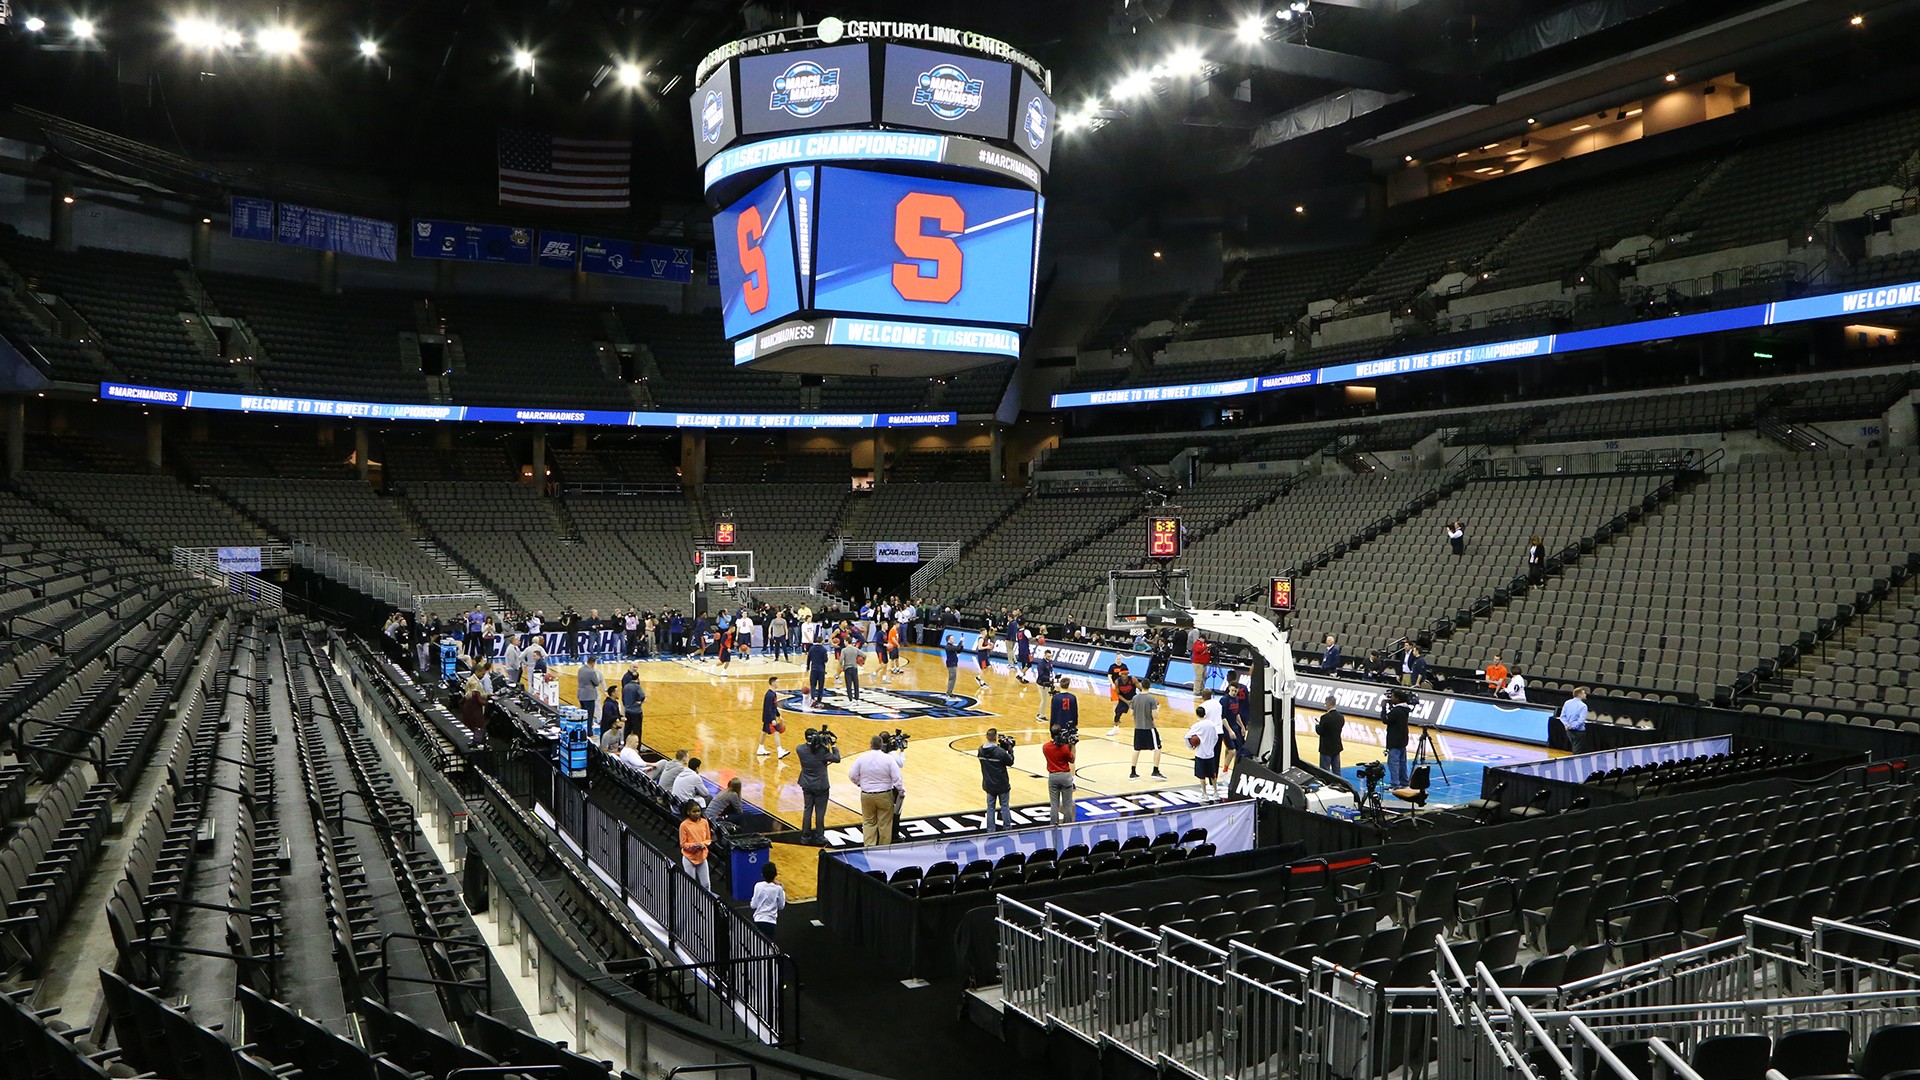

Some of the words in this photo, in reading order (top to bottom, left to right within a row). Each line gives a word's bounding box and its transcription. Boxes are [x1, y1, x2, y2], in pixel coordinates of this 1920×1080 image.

[847, 20, 961, 46] CENTURYLINK
[785, 74, 821, 90] MARCH
[929, 76, 965, 93] MARCH
[789, 84, 838, 103] MADNESS
[933, 88, 980, 107] MADNESS
[806, 135, 937, 157] CHAMPIONSHIP
[542, 248, 576, 257] EAST
[546, 241, 571, 250] BIG
[1843, 286, 1920, 311] WELCOME
[848, 323, 927, 345] WELCOME
[1356, 361, 1396, 377] WELCOME
[1398, 358, 1410, 371] TO
[1412, 356, 1429, 370] THE
[1431, 351, 1462, 368] SWEET
[1262, 373, 1311, 389] #MARCHMADNESS
[108, 385, 178, 402] #MARCHMADNESS
[1090, 391, 1129, 404] WELCOME
[1131, 390, 1142, 401] TO
[1144, 389, 1159, 401] THE
[1161, 386, 1190, 400] SWEET
[241, 396, 293, 412] WELCOME
[297, 398, 311, 412] TO
[314, 399, 333, 413] THE
[335, 401, 369, 416] SWEET
[516, 411, 585, 422] #MARCHMADNESS
[676, 414, 723, 426] WELCOME
[725, 415, 738, 426] TO
[740, 415, 757, 427] THE
[759, 415, 792, 427] SWEET
[888, 414, 950, 425] #MARCHMADNESS
[1862, 426, 1880, 435] 106
[1605, 441, 1619, 449] 105
[718, 531, 731, 542] 25
[1154, 533, 1174, 552] 25
[878, 548, 917, 556] NCAA.com
[1276, 592, 1288, 605] 25
[1057, 648, 1090, 667] SIXTEEN
[1308, 683, 1331, 707] THE
[1332, 687, 1378, 711] SWEET
[1235, 773, 1286, 805] NCAA
